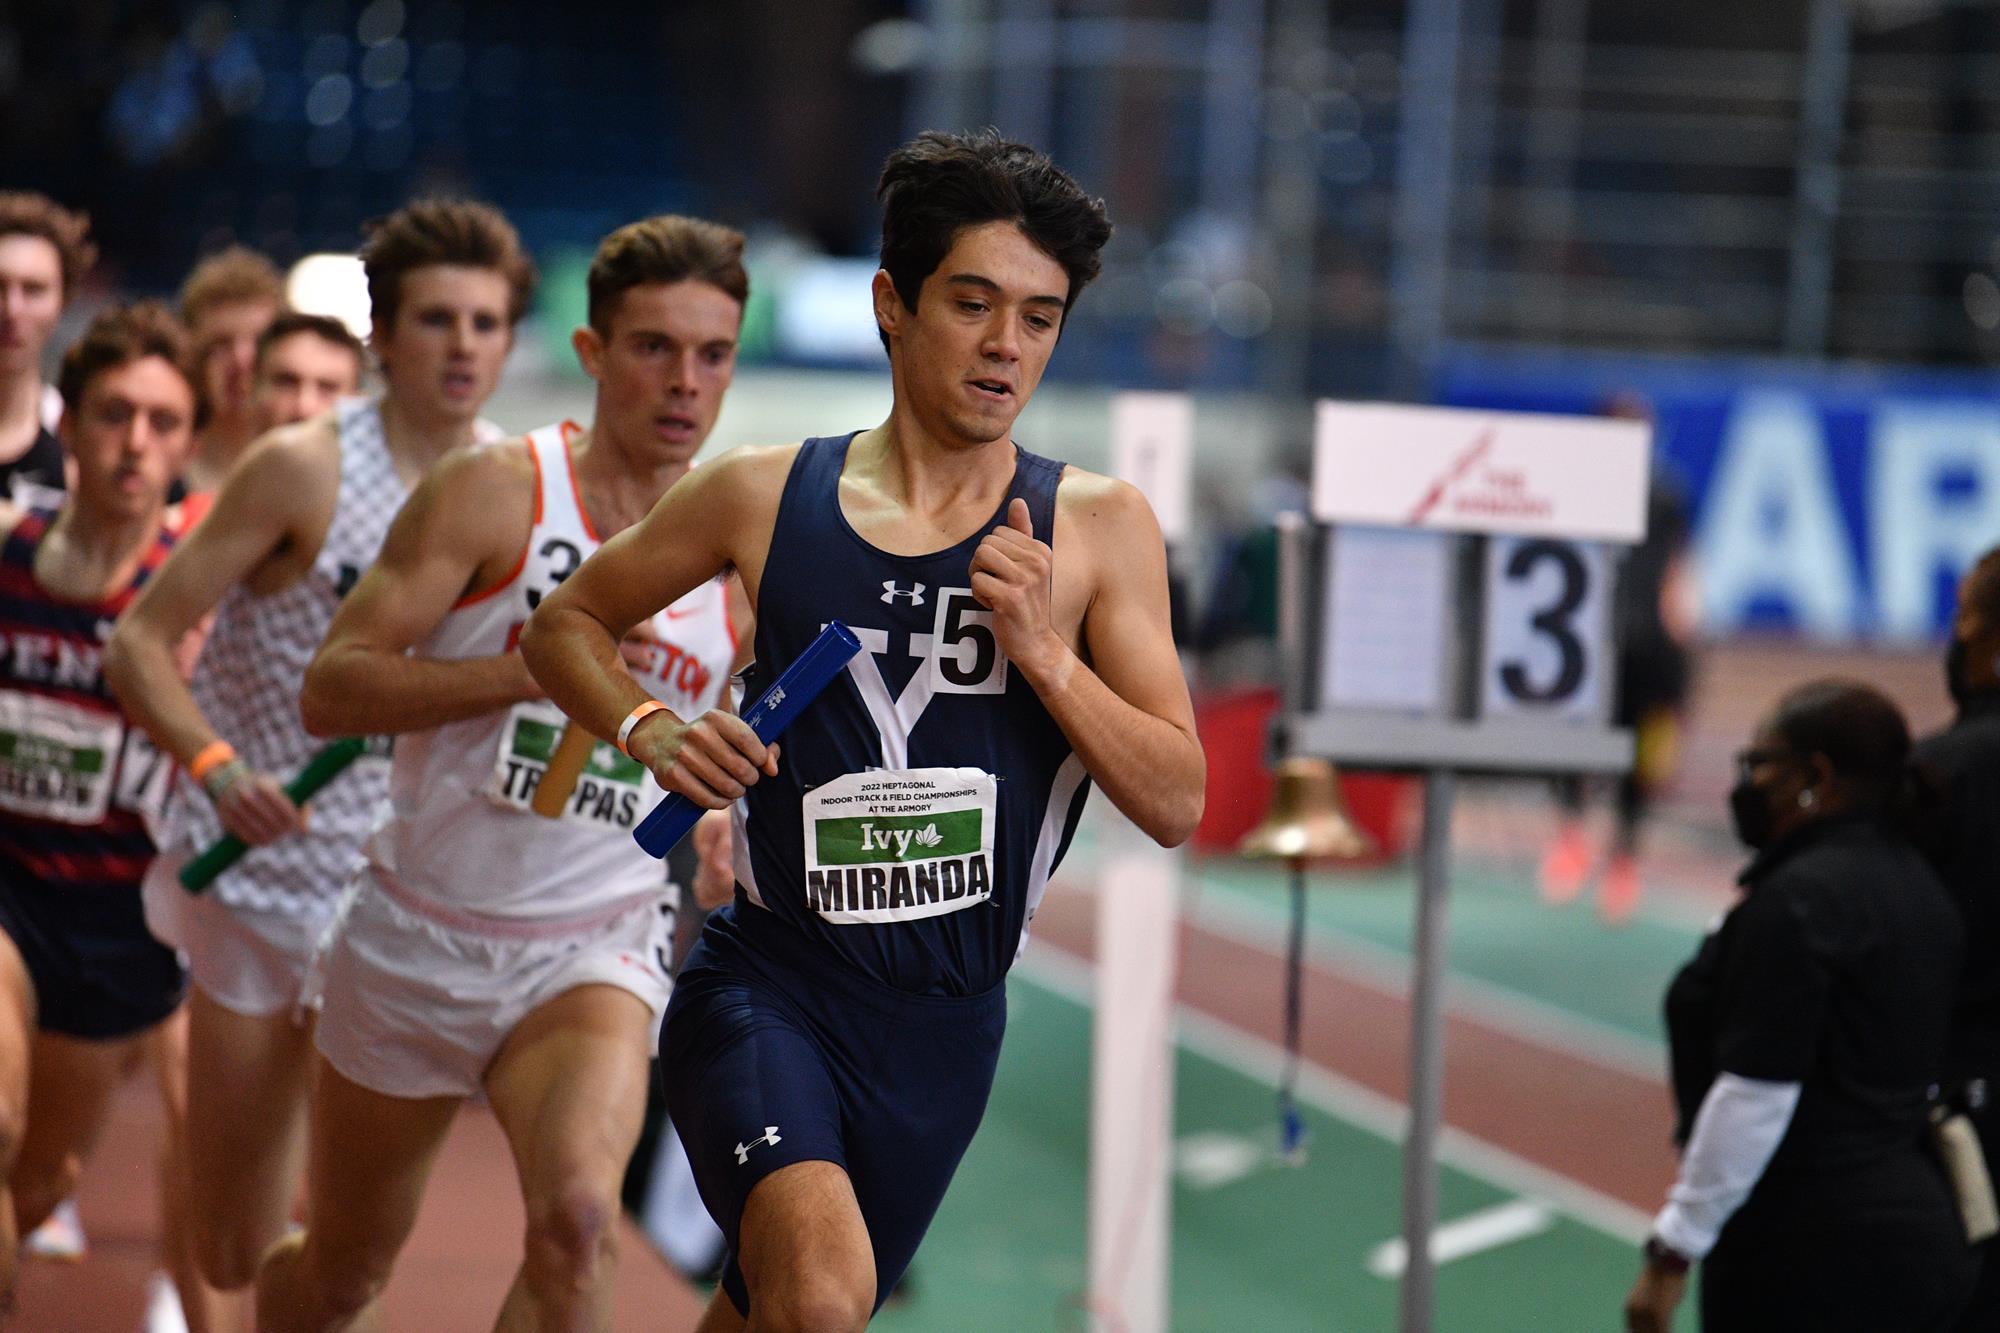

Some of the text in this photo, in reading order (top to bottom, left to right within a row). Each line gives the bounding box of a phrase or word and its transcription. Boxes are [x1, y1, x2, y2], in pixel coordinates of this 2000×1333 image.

[939, 595, 996, 685] 5
[1499, 540, 1589, 704] 3
[820, 623, 934, 769] Y
[503, 760, 639, 828] TRPAS
[821, 796, 853, 805] INDOOR
[854, 794, 881, 802] TRACK
[889, 792, 912, 801] FIELD
[913, 789, 977, 801] CHAMPIONSHIPS
[861, 781, 936, 791] 2022 HEPTAGONAL
[868, 804, 932, 813] AT THE ARMORY
[860, 823, 914, 857] Ivy
[808, 854, 990, 912] MIRANDA
